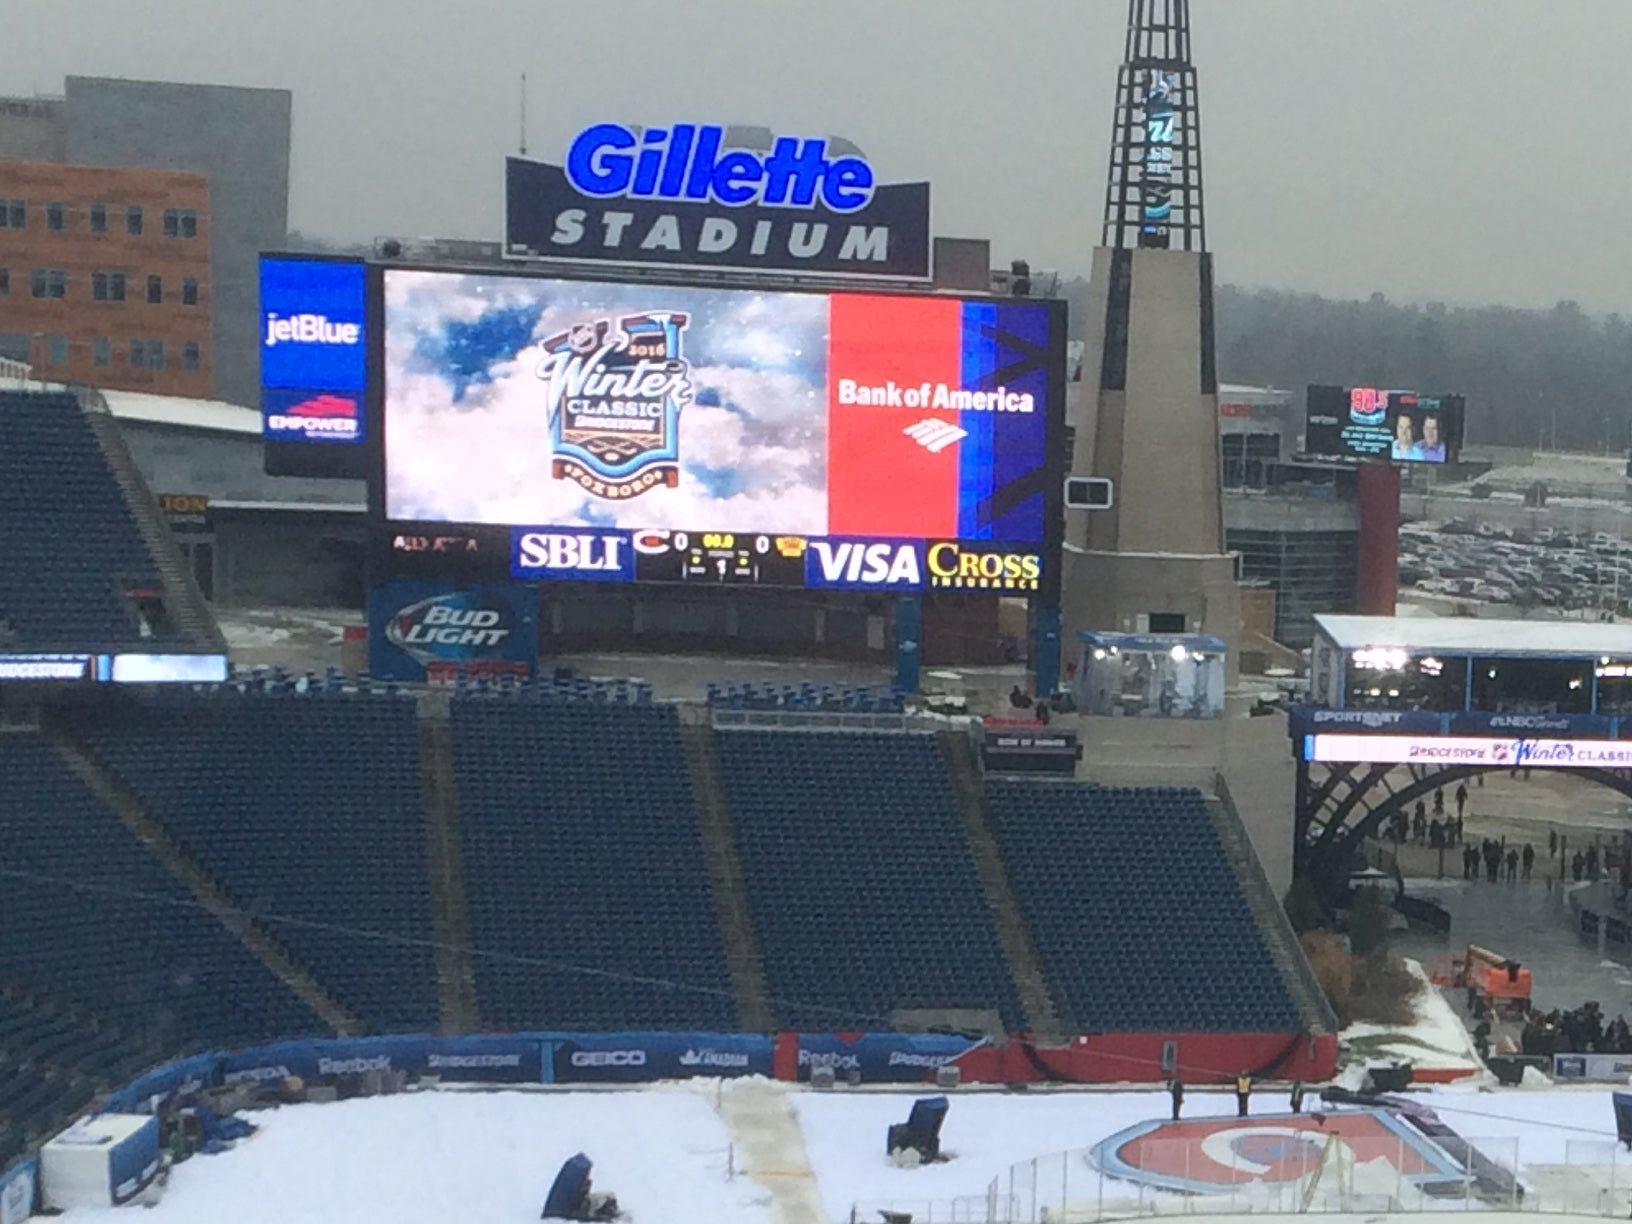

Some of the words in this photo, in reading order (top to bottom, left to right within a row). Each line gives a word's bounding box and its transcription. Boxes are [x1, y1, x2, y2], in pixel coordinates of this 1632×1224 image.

[564, 121, 875, 213] Gillette
[551, 209, 888, 262] STADIUM
[265, 312, 359, 346] jetBlue
[536, 342, 693, 416] Winter
[567, 399, 662, 417] CLASSIC
[838, 379, 902, 407] Bank
[903, 383, 931, 408] of
[932, 384, 1034, 413] America
[268, 415, 357, 432] EMPOWER
[520, 533, 622, 571] SBLI
[674, 532, 688, 551] 0
[755, 535, 770, 554] 0
[809, 542, 920, 584] VISA
[928, 543, 1040, 579] CROSS
[931, 577, 1039, 590] INSURANCE
[423, 605, 499, 627] BUD
[405, 626, 509, 646] LIGHT
[1511, 738, 1574, 765] Winter
[317, 1055, 393, 1075] Reebok
[571, 1050, 646, 1067] GEICO
